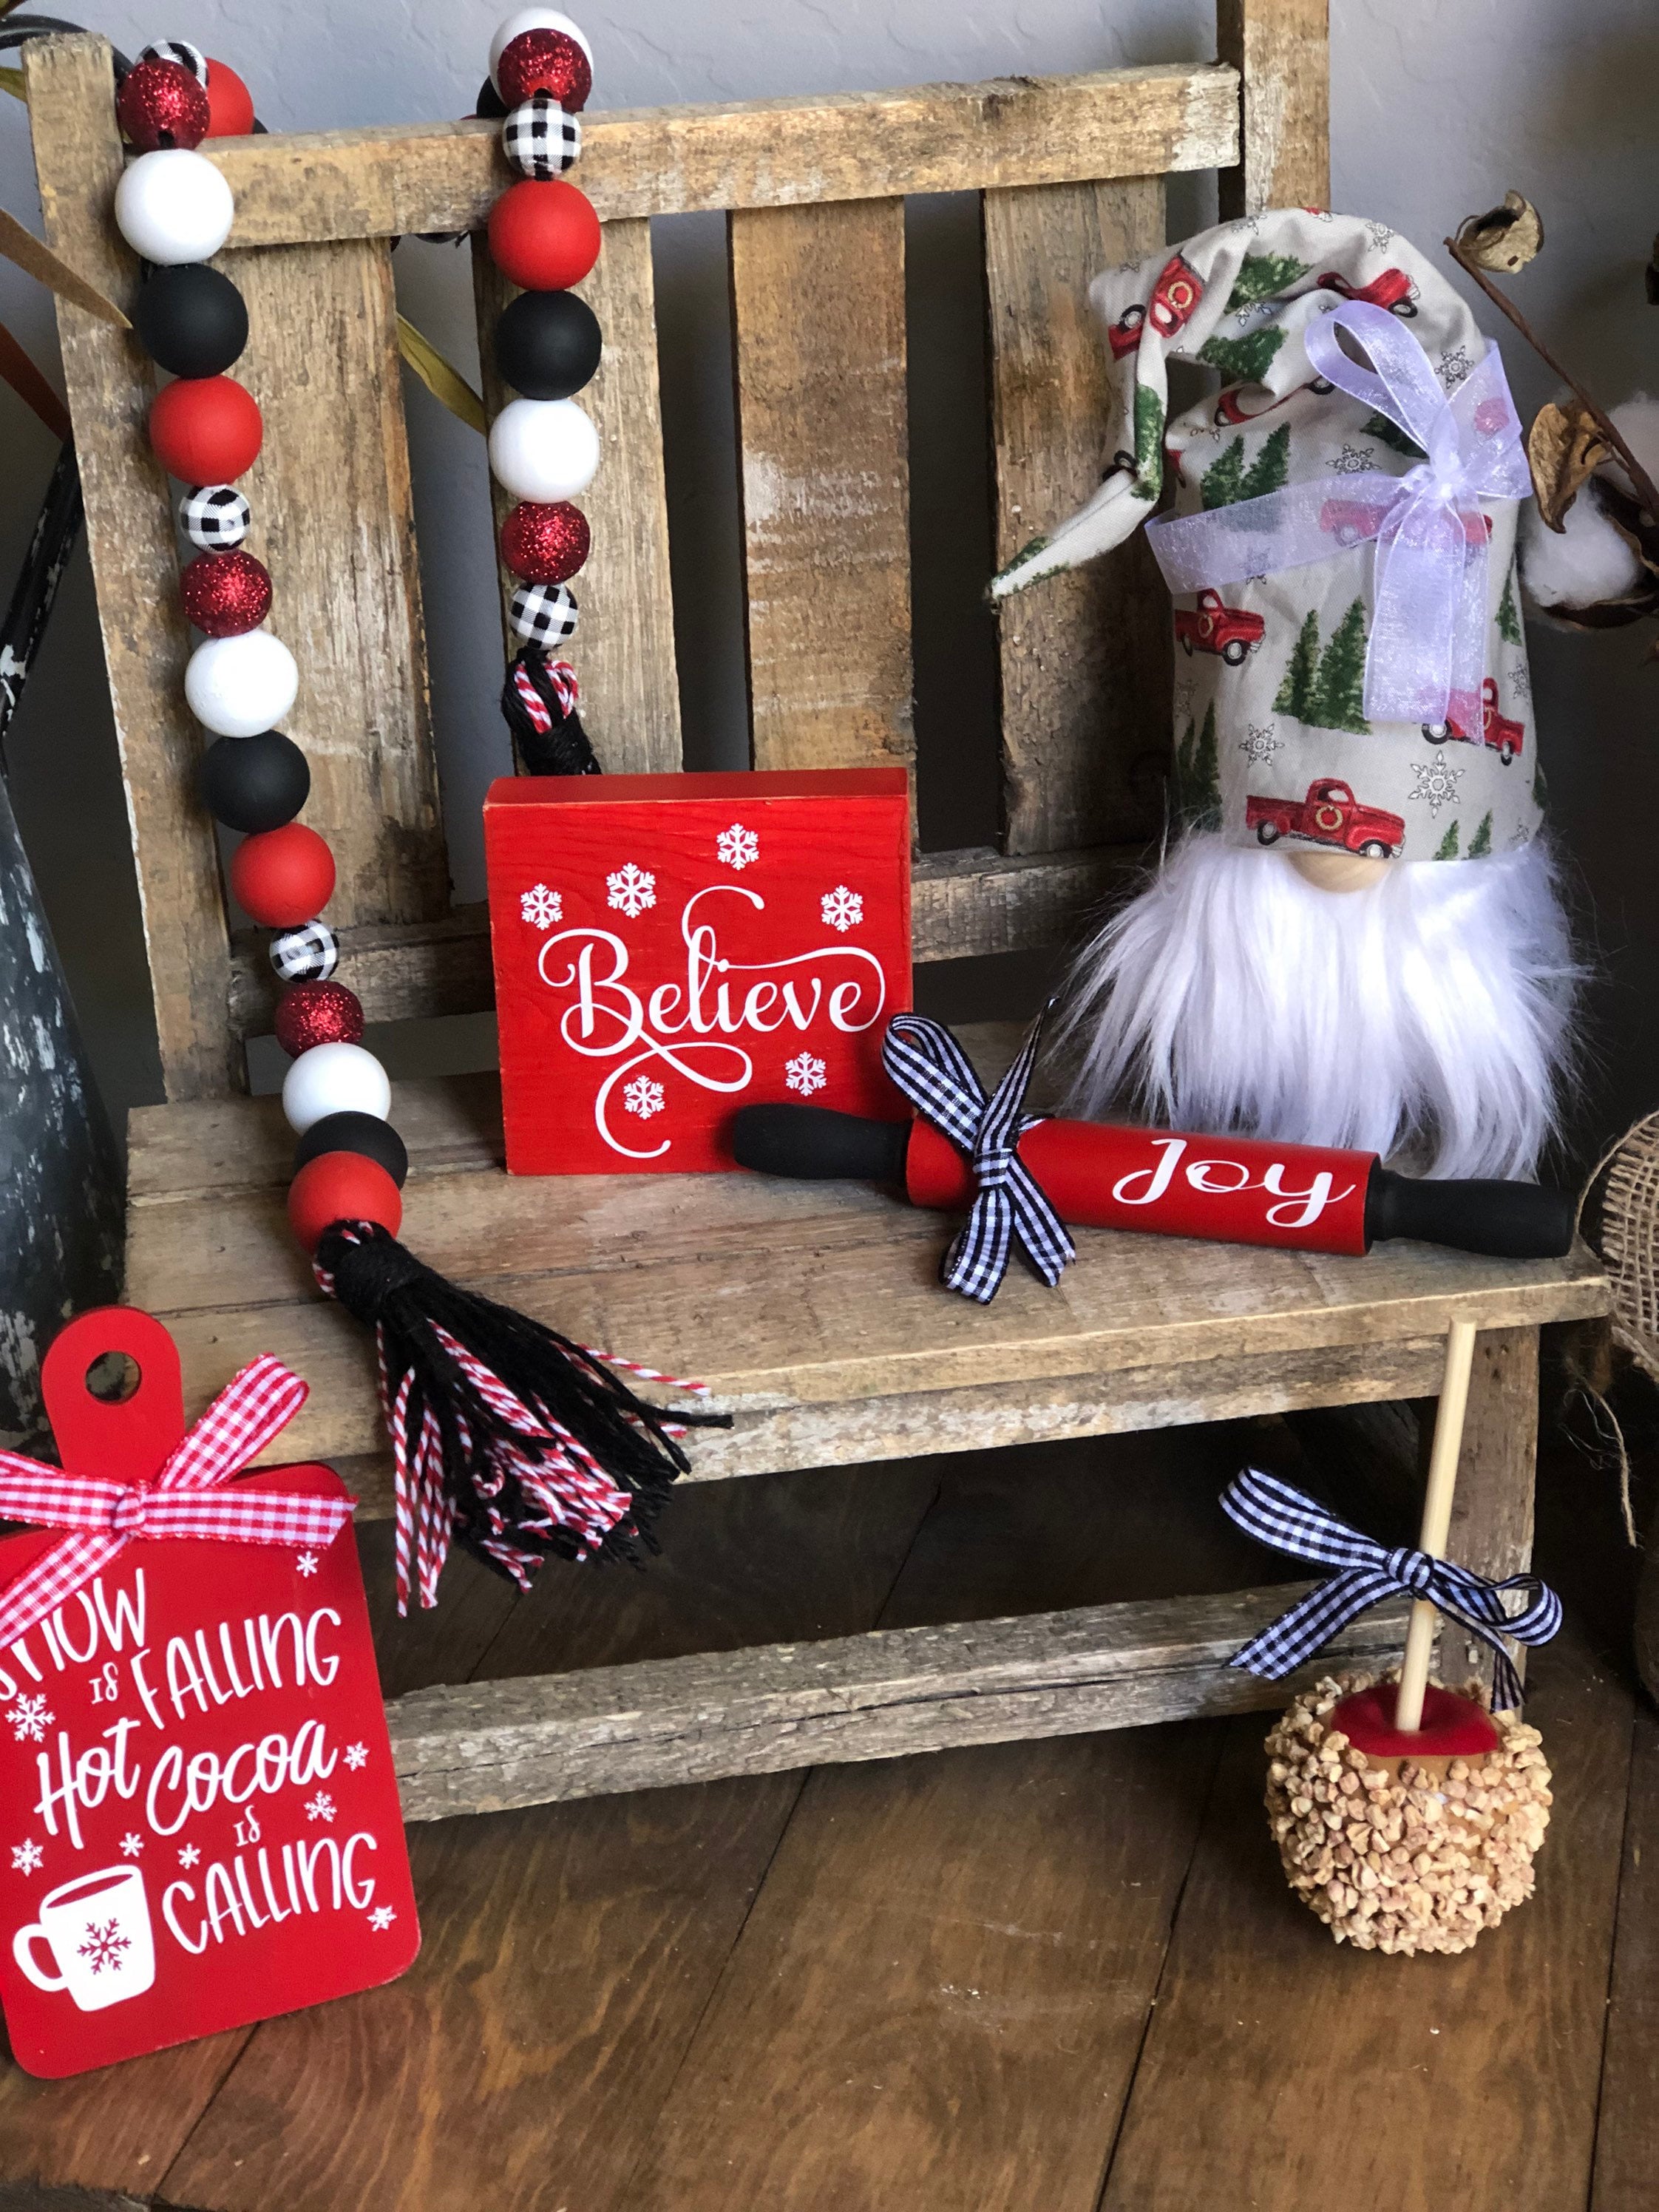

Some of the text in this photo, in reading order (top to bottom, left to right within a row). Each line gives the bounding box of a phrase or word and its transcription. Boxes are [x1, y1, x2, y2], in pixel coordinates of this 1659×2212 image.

[538, 885, 886, 1158] Believe
[1113, 1139, 1356, 1228] Joy
[130, 1608, 342, 1730] FALLING
[162, 1832, 377, 1955] CALLING
